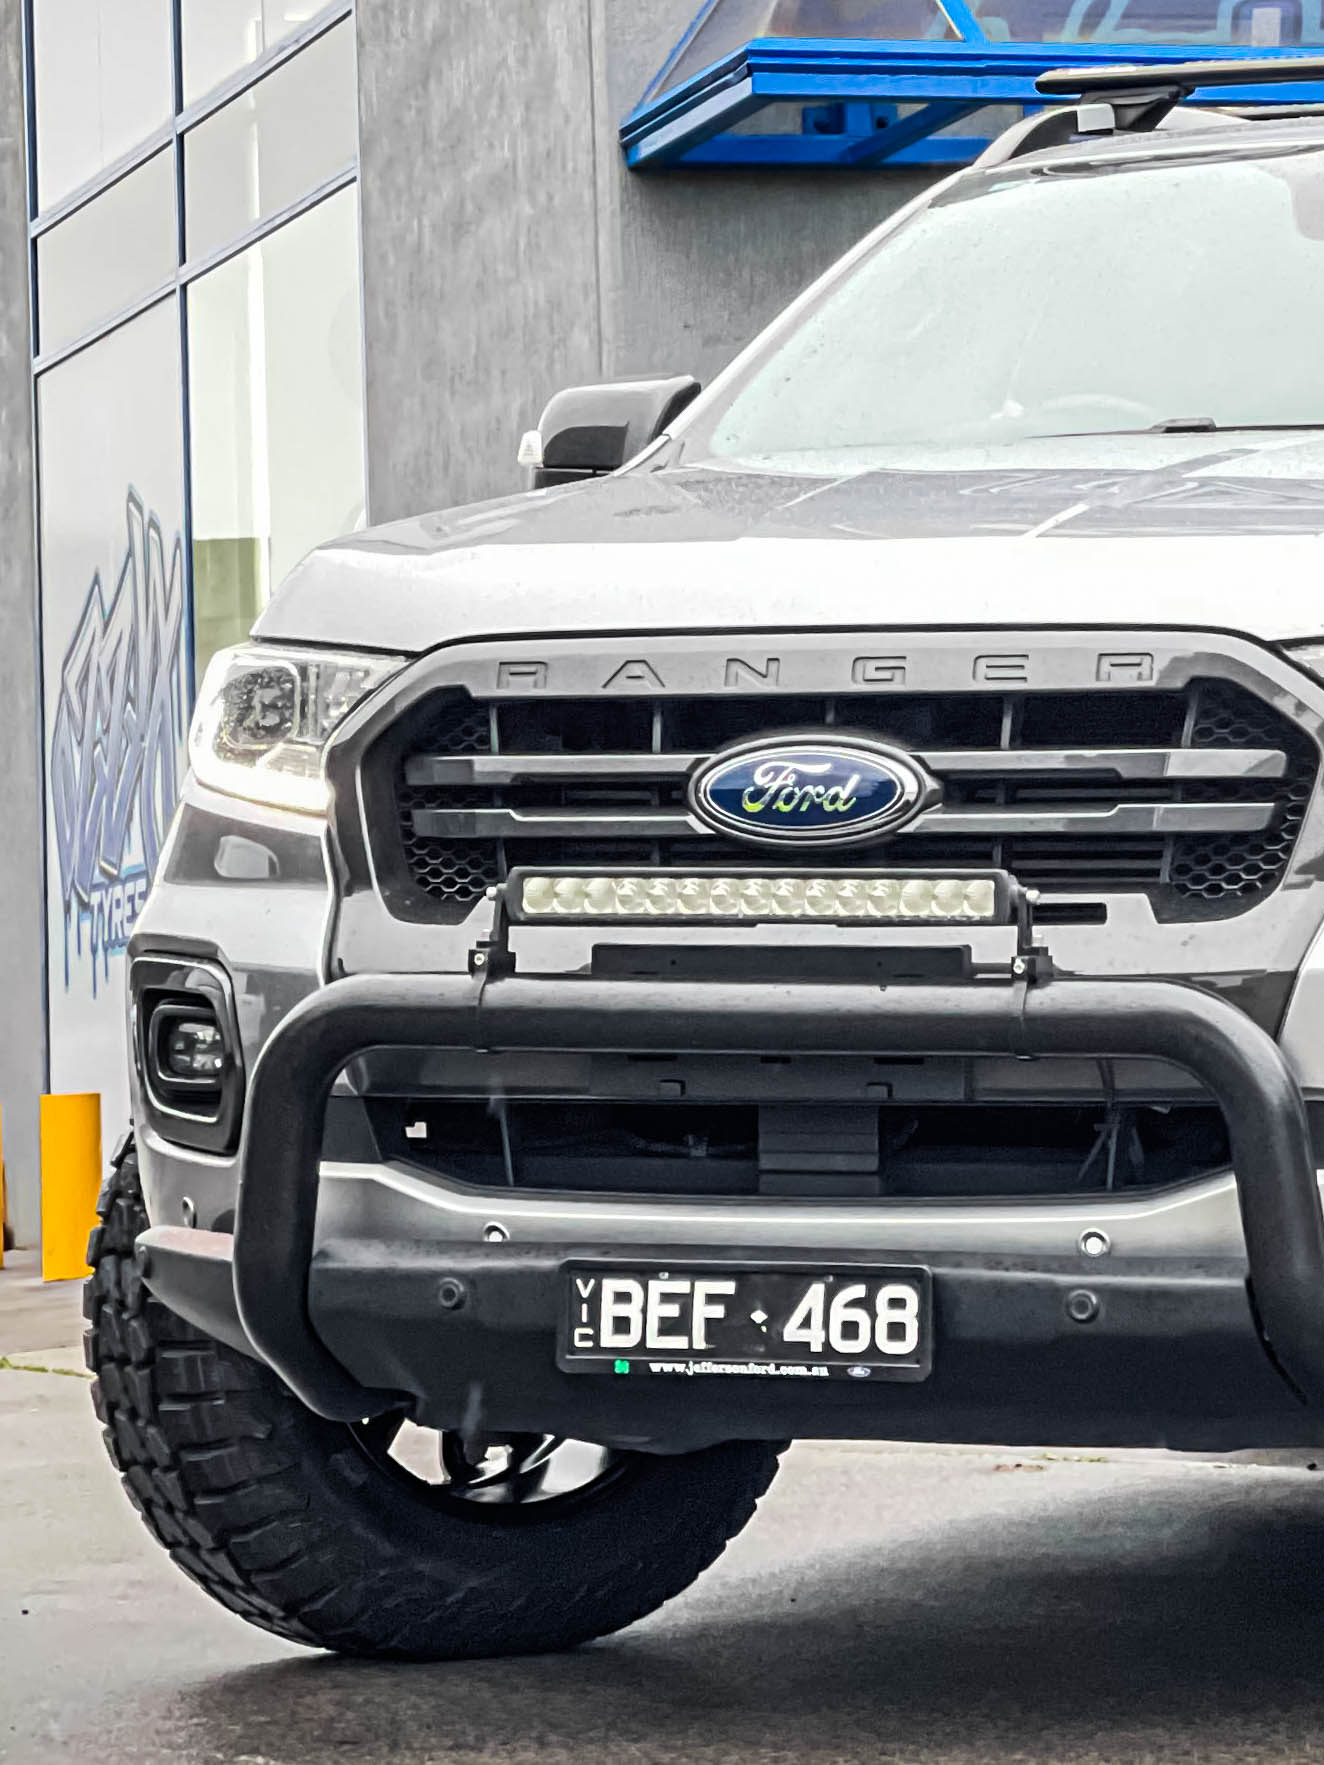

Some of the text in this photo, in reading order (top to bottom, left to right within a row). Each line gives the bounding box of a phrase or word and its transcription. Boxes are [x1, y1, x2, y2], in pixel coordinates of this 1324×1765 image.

[496, 653, 1154, 690] RANGER
[742, 761, 861, 813] Ford
[574, 1278, 594, 1348] VIC
[600, 1279, 919, 1355] BEF 468
